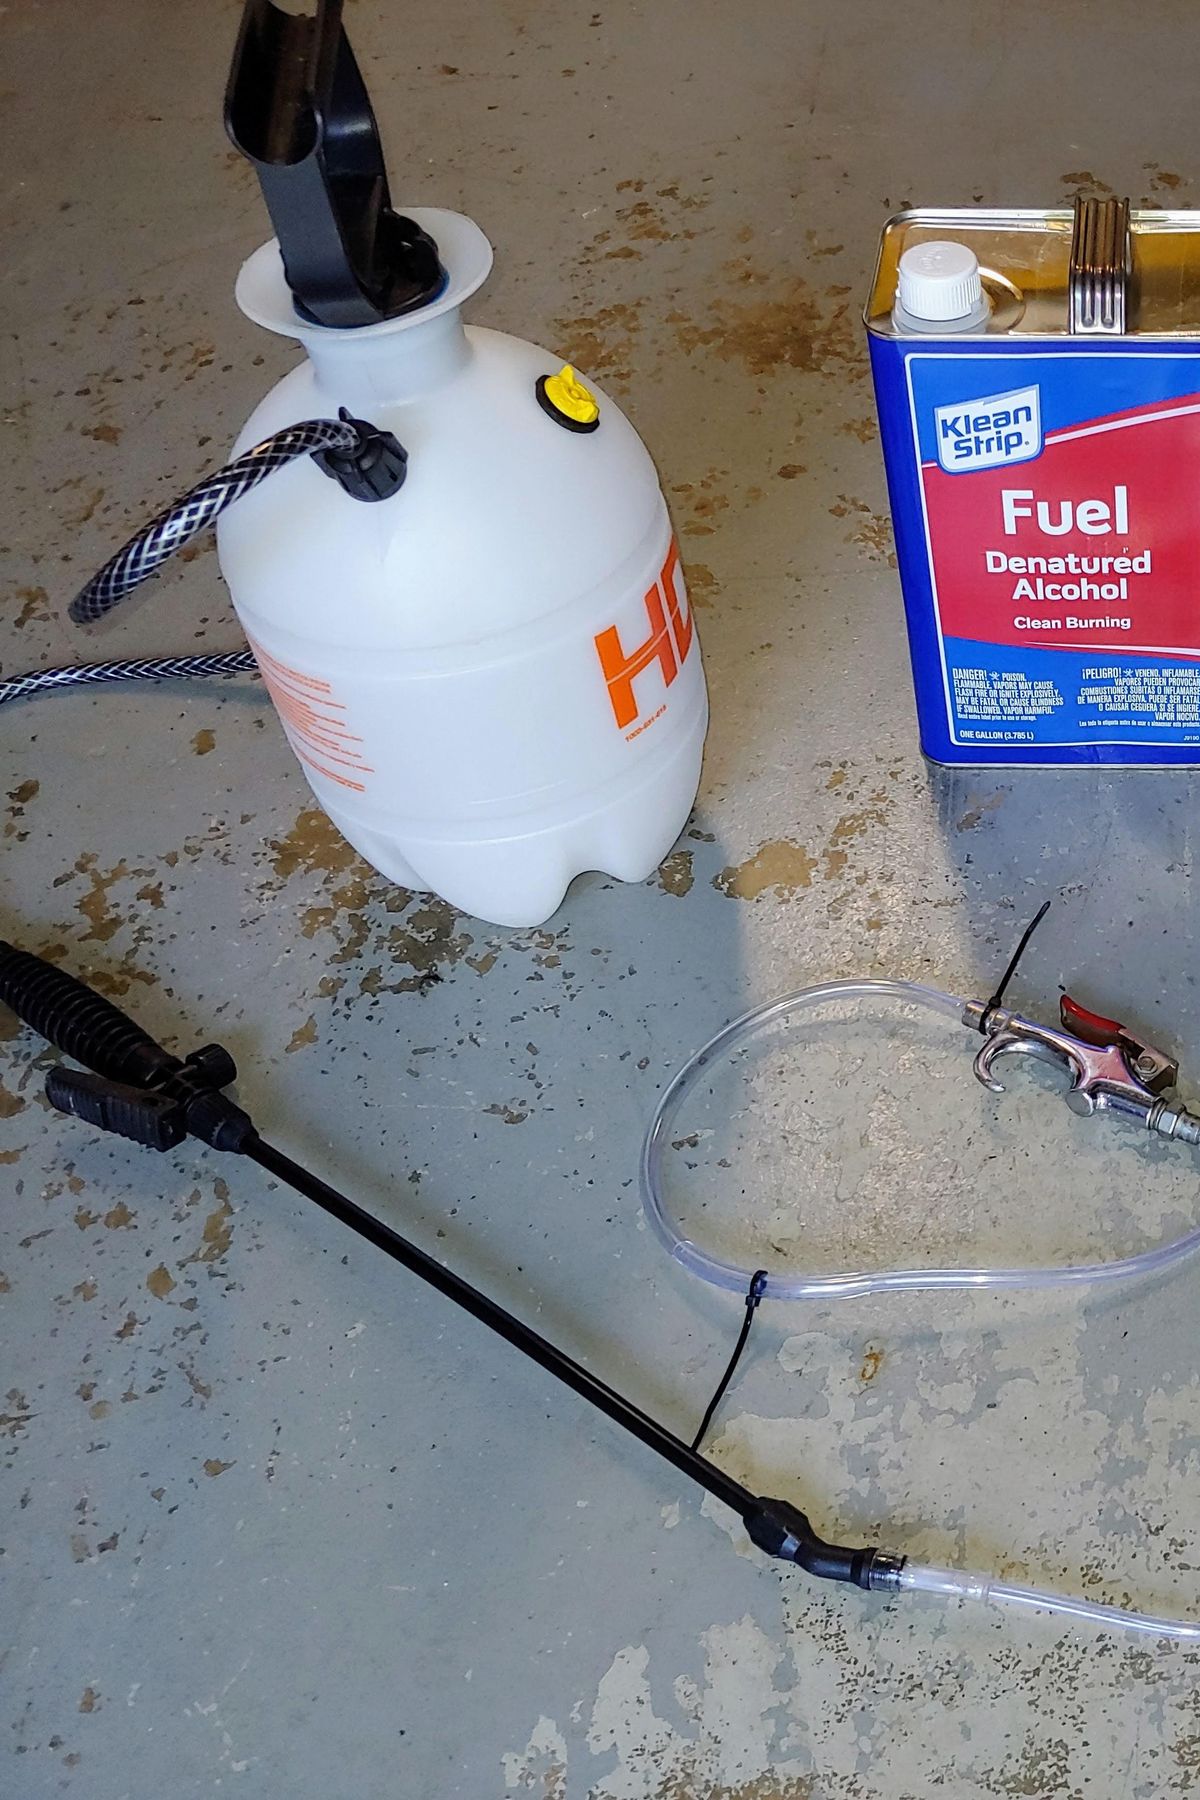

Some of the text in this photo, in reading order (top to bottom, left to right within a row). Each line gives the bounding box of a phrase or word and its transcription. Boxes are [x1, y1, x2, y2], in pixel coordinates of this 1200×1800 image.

[941, 406, 1032, 438] Klean
[954, 430, 1023, 460] Strip
[1001, 485, 1129, 536] Fuel
[985, 550, 1152, 575] Denatured
[1012, 577, 1128, 600] Alcohol
[1014, 616, 1131, 630] Clean Burning
[952, 668, 987, 680] DANGER!
[1002, 672, 1027, 681] POISON.
[1082, 667, 1121, 679] ¡PELIGRO!
[954, 680, 1054, 689] FLAMMABLE. VAPORS MAY CAUSE
[1114, 678, 1200, 686] VAPORES PUEDEN PROVOCAR
[955, 688, 1060, 698] FLASH FIRE OR IGNITE EXPLOSIVELY.
[1081, 686, 1128, 696] COMBUSTIONES
[1164, 686, 1200, 695] INFLAMARSE
[956, 697, 1064, 706] MAY BE FATAL OR CAUSE BLINDNESS
[1077, 695, 1200, 704] DE MANERA EXPLOSIVA. PUEDE SER FATAL
[957, 705, 1055, 715] IF SWALLOWED. VAPOR HARMFUL.
[1105, 703, 1129, 711] CAUSAR
[1130, 703, 1157, 712] CEGUERA
[1160, 704, 1166, 712] SI
[1167, 704, 1174, 712] SE
[1154, 712, 1200, 721] VAPOR NOCIVO.
[960, 730, 974, 738] ONE
[975, 730, 1003, 739] GALLON
[1027, 731, 1034, 741] L)
